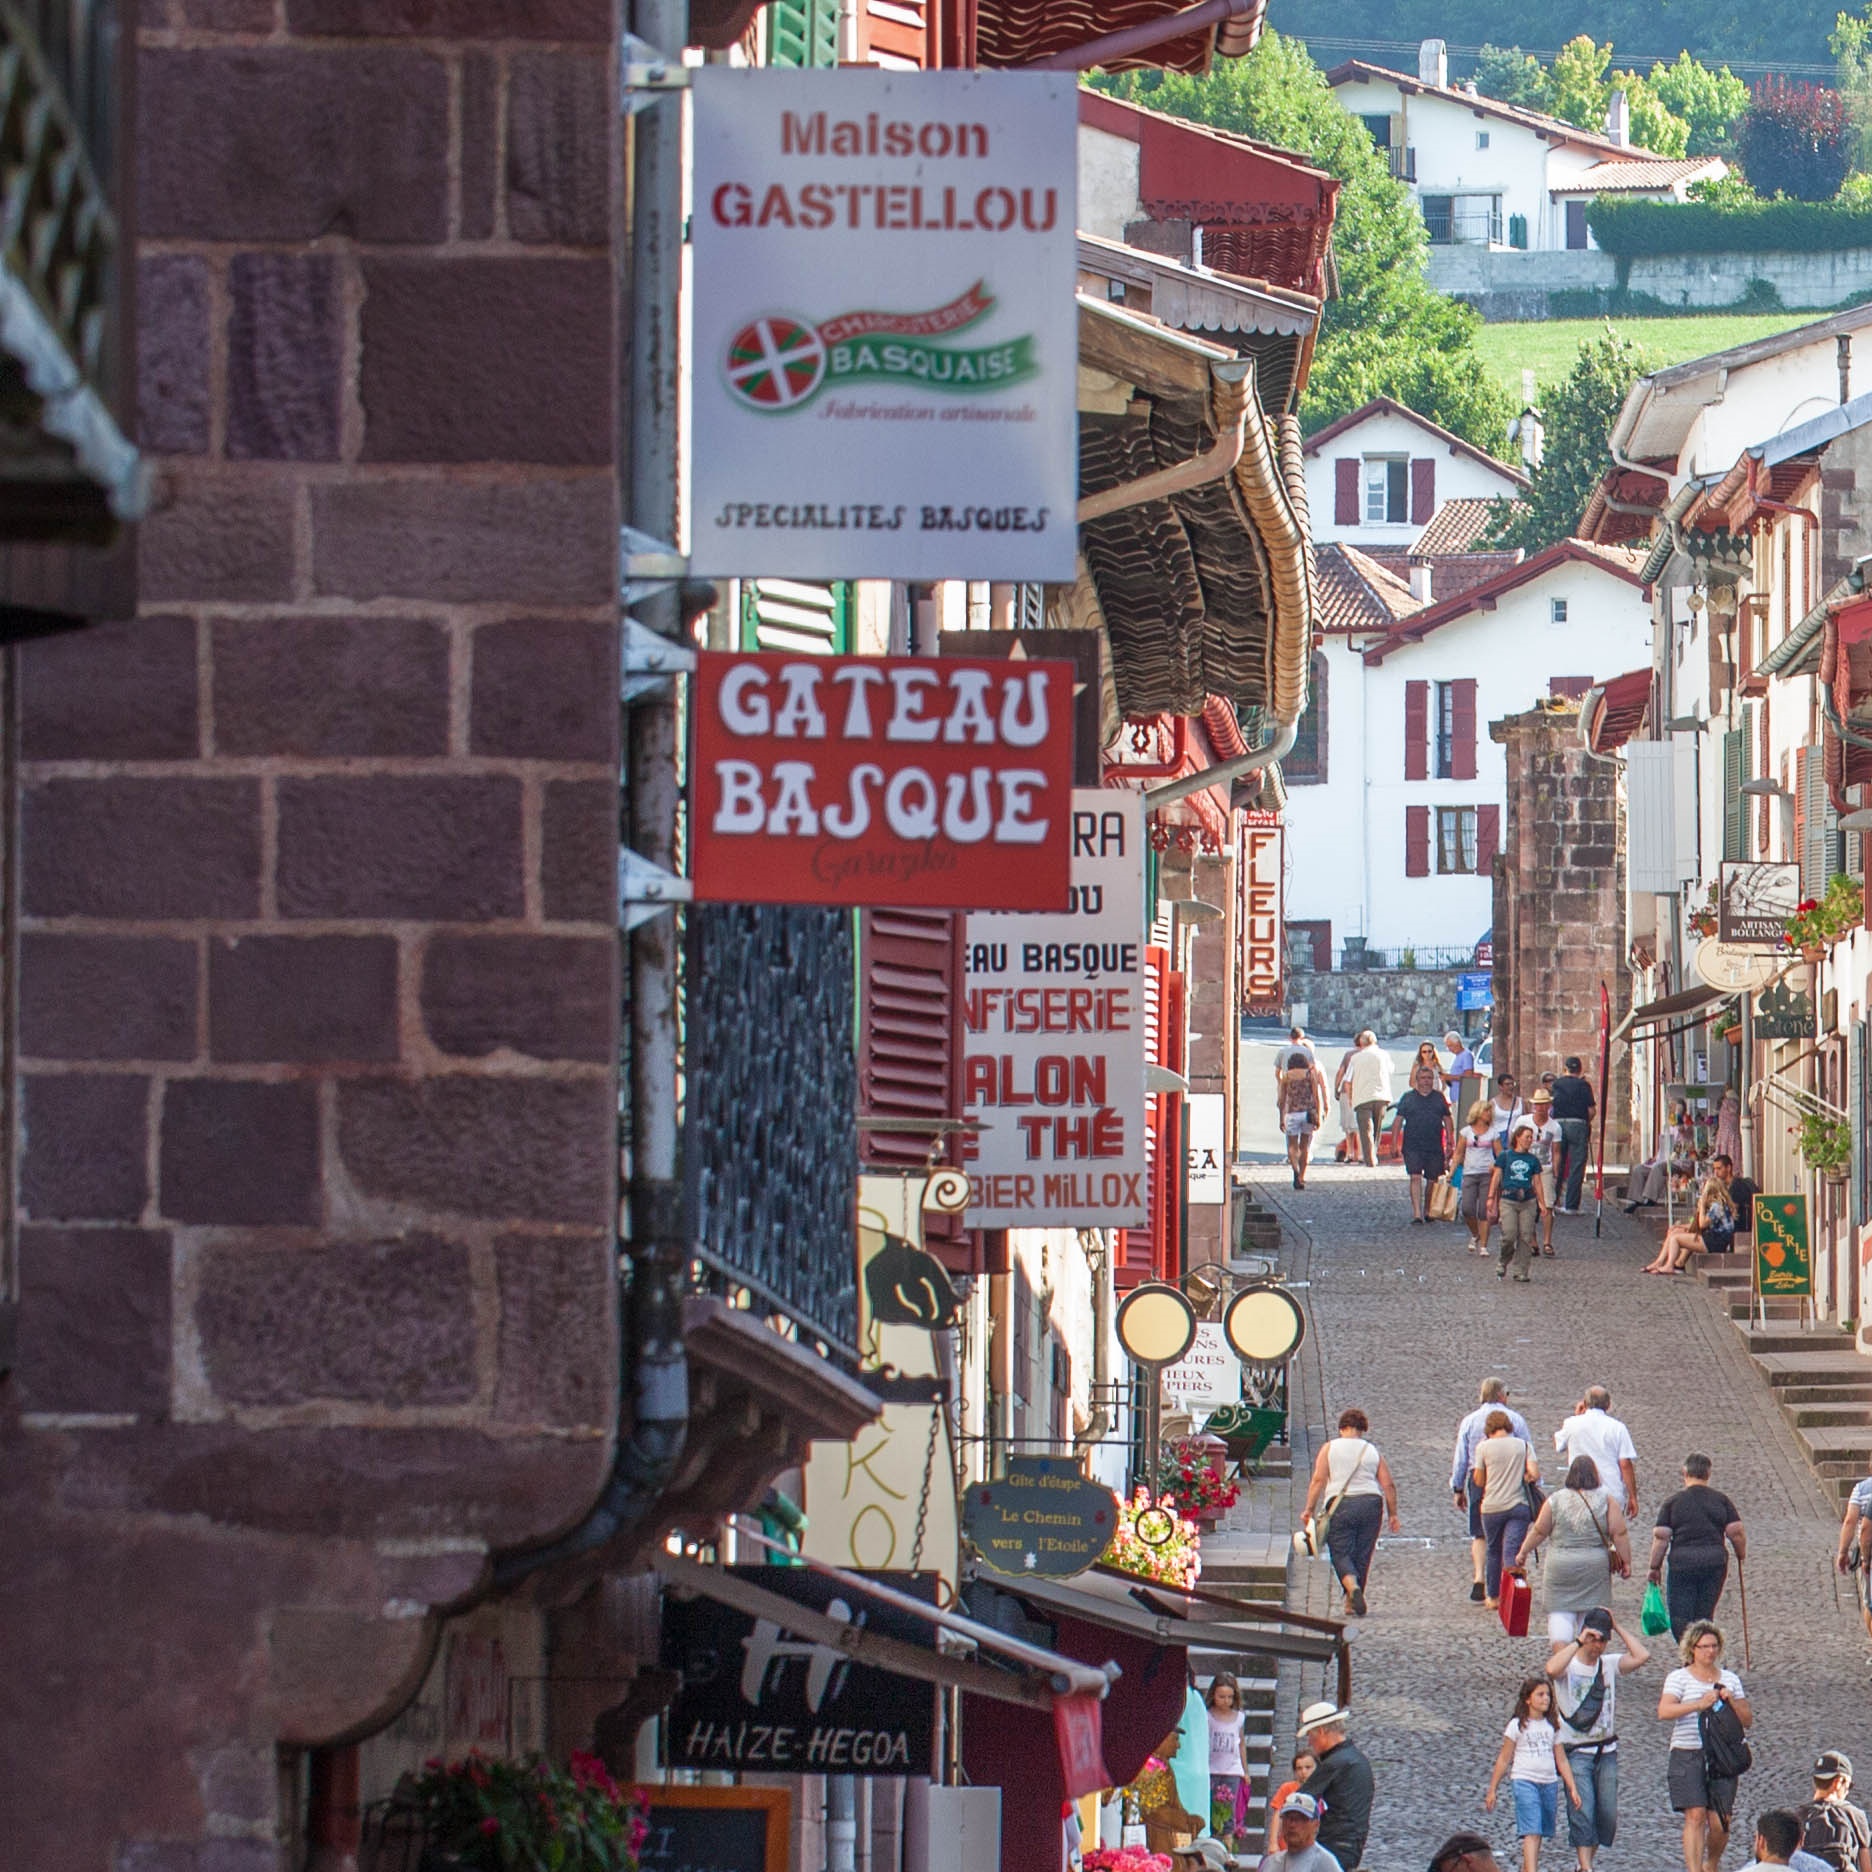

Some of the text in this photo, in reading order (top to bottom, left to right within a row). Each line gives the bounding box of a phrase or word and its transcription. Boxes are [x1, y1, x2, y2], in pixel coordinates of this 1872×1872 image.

[781, 111, 990, 158] Maison
[711, 182, 1058, 233] GASTELLOU
[830, 345, 1017, 382] BASQUAISE
[714, 502, 1051, 533] SPECIALITES BASQUES
[718, 662, 1050, 747] GATEAU
[712, 758, 1050, 844] BASQUE
[1250, 832, 1276, 997] FLEURS
[1740, 920, 1782, 929] ARTISAN
[1022, 943, 1138, 980] BASQUE
[1017, 1107, 1125, 1161] THÉ
[1756, 1201, 1808, 1262] POTERIE
[1023, 1509, 1082, 1527] Chemin
[991, 1537, 1023, 1550] vers
[688, 1719, 911, 1766] HAIZE-HEGOA
